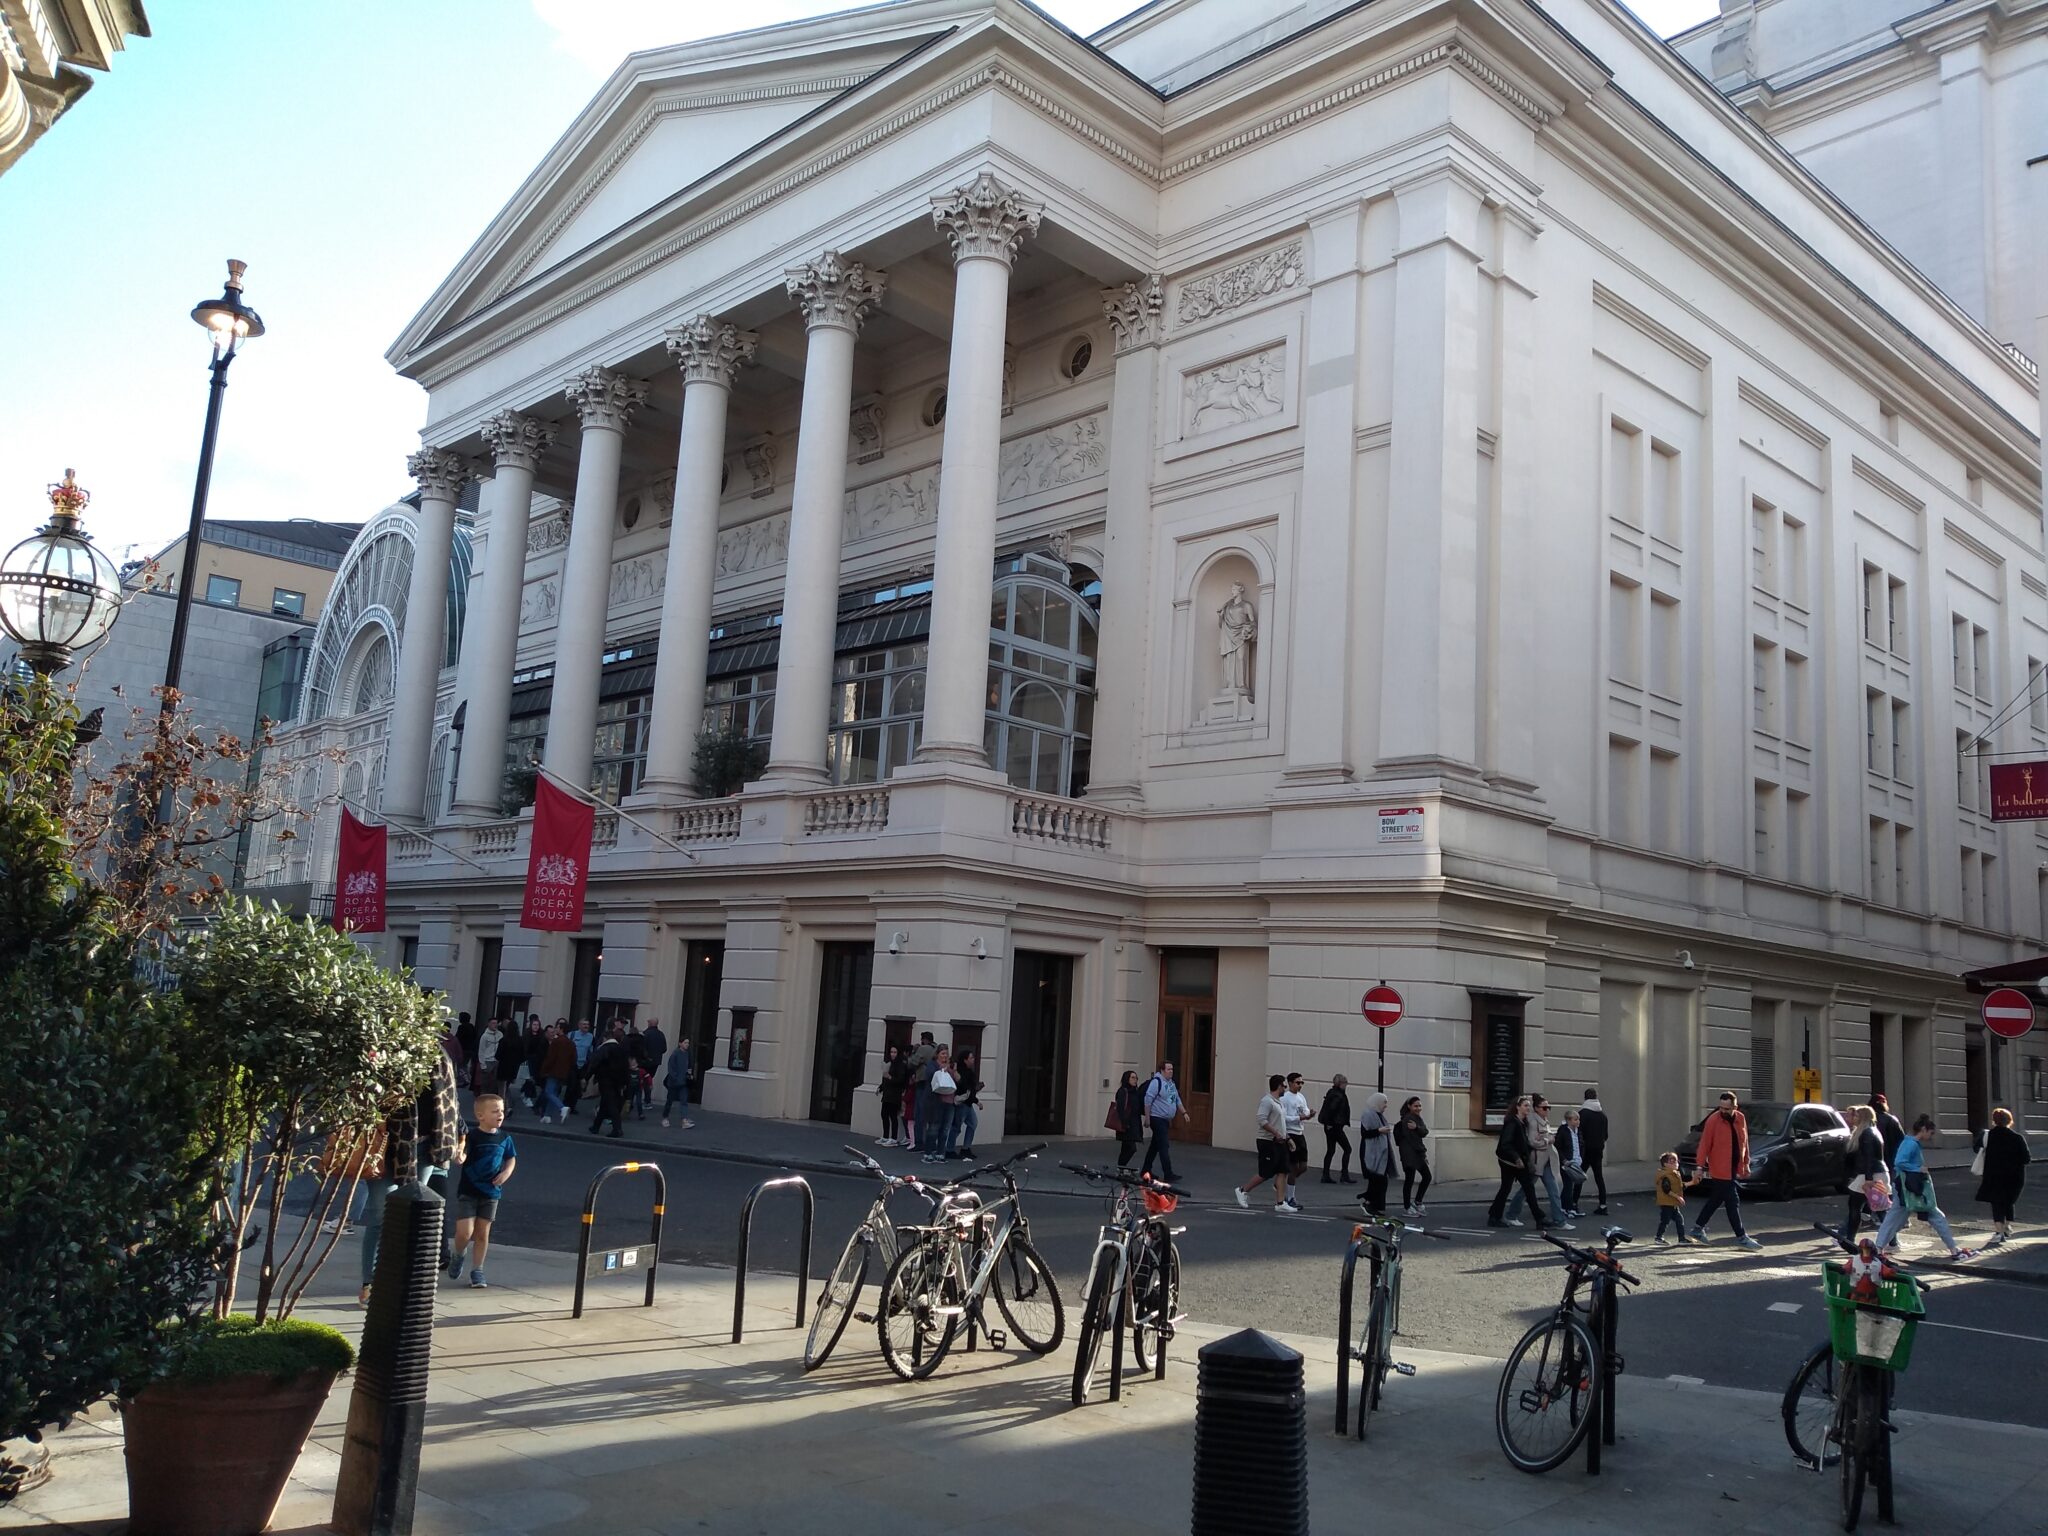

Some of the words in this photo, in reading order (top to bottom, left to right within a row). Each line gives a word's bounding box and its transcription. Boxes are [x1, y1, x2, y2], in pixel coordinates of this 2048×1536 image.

[1381, 825, 1404, 834] STREET
[1405, 824, 1420, 832] WC2
[535, 885, 574, 898] ROYAL
[344, 897, 377, 905] ROAL
[532, 897, 574, 909] OPERA
[343, 906, 378, 915] OPERA
[530, 909, 573, 920] HOUSE
[1443, 1060, 1459, 1069] FLORAL
[1443, 1069, 1459, 1078] STREET
